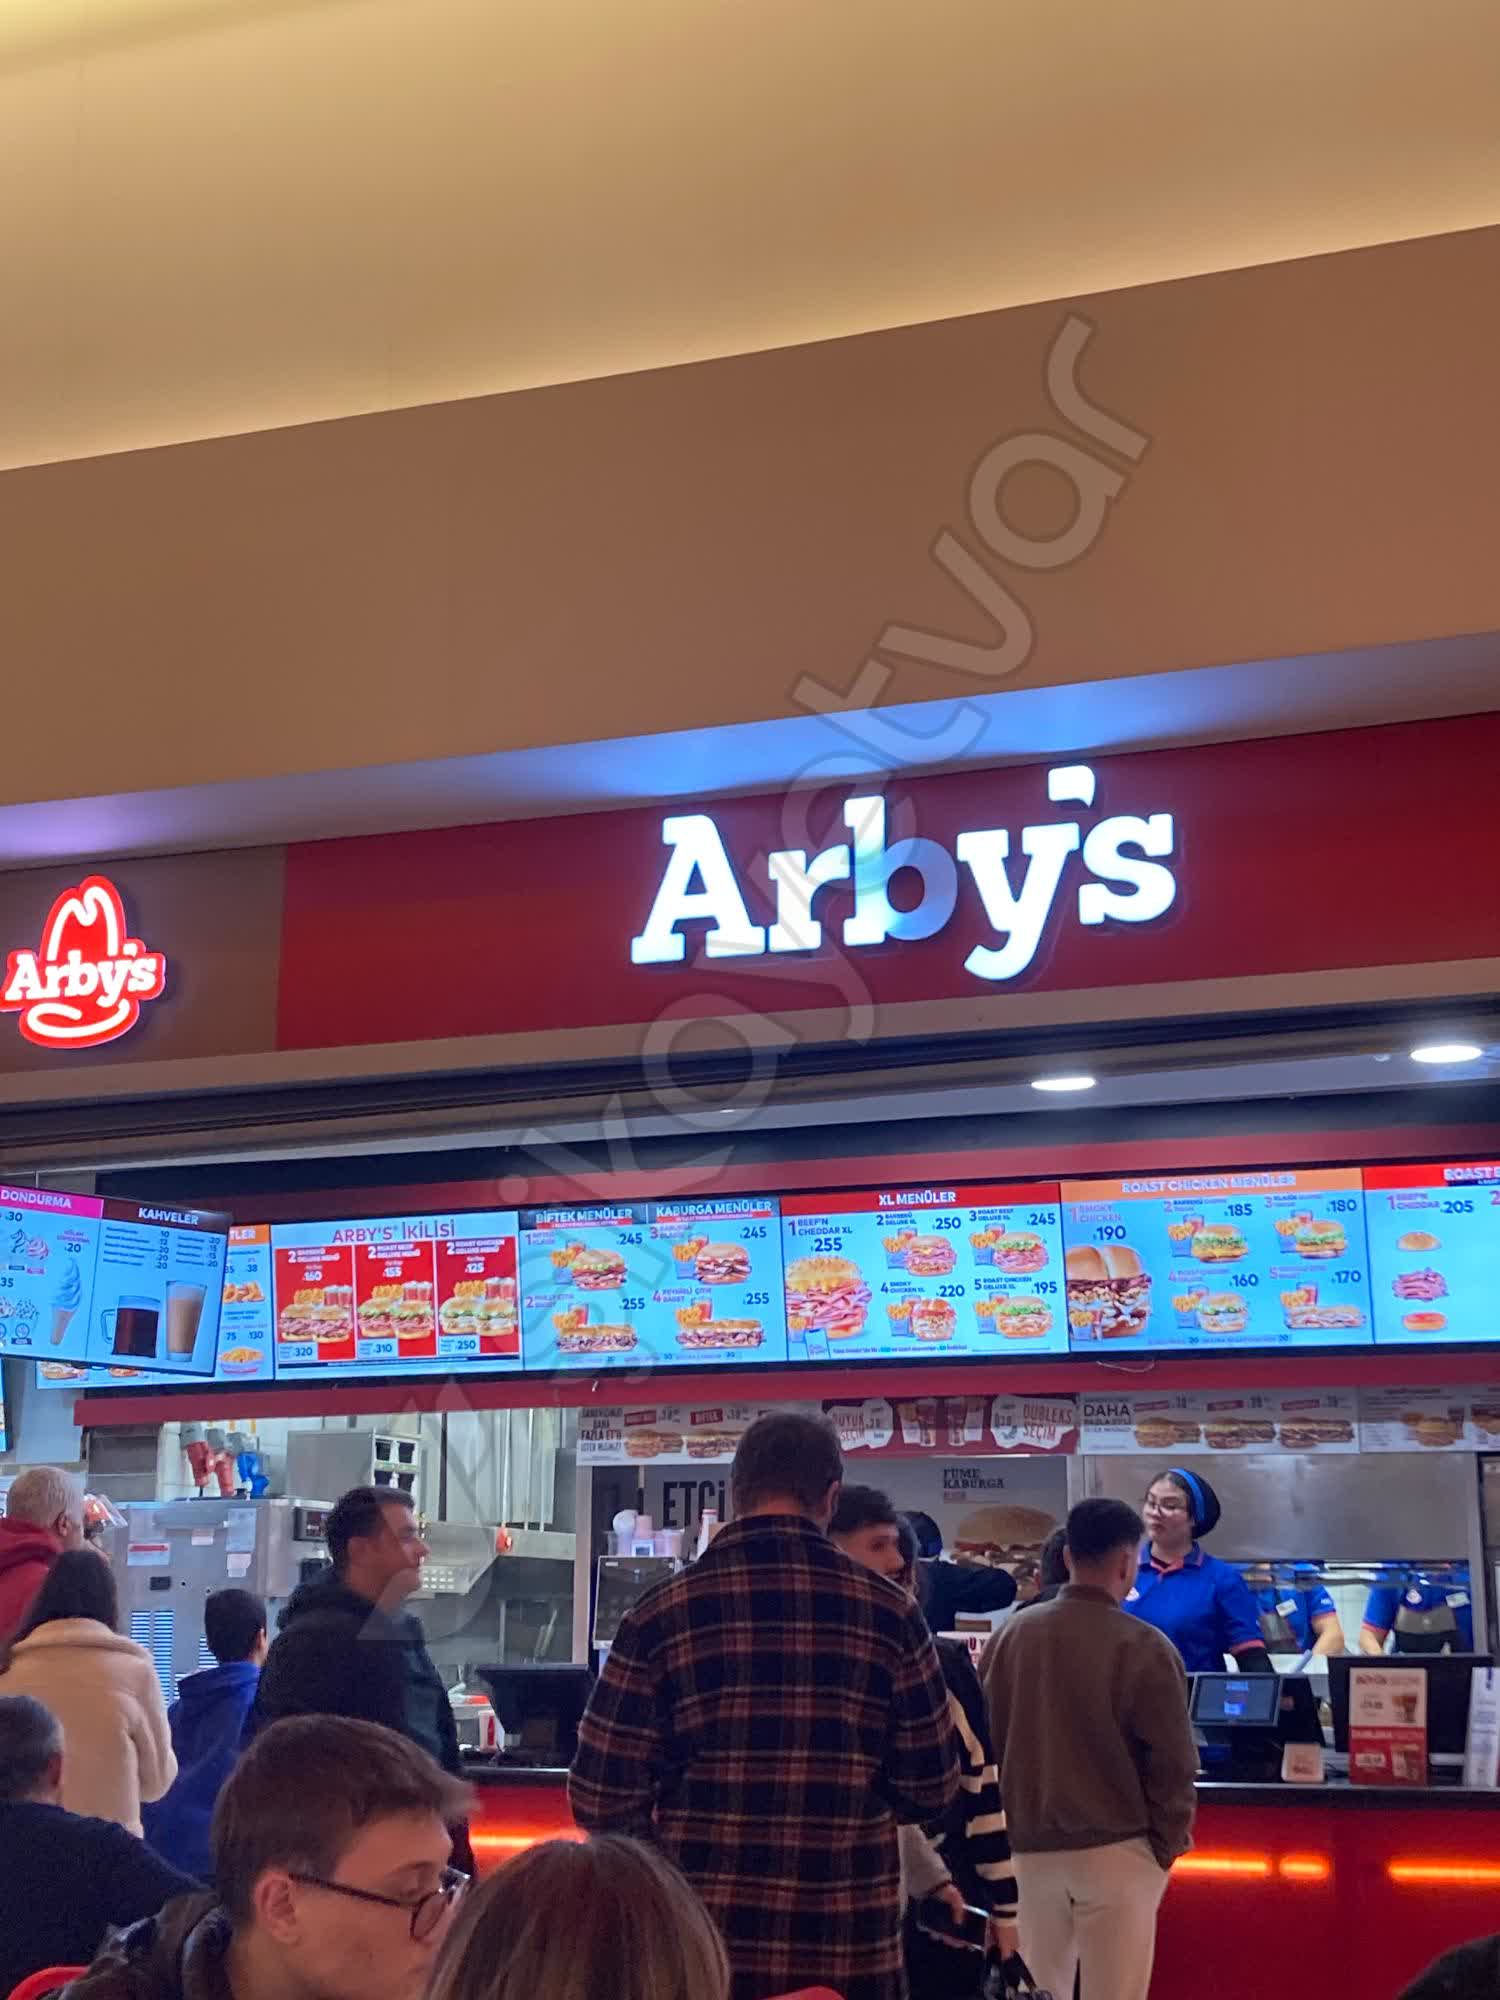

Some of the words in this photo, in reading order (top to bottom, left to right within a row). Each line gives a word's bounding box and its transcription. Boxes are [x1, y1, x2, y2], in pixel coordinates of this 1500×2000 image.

[631, 765, 1177, 981] Arby's
[4, 943, 157, 1009] Arby's
[1444, 1166, 1493, 1181] ROAST
[1121, 1181, 1165, 1194] ROAST
[1167, 1177, 1229, 1192] CHICKEN
[1, 1189, 72, 1209] DONDURMA
[878, 1195, 895, 1206] XL
[896, 1190, 957, 1205] MENÜLER
[577, 1207, 633, 1221] MENÜLER
[656, 1204, 713, 1217] KABURGA
[715, 1200, 772, 1215] MENÜLER
[1227, 1203, 1253, 1217] 185
[1442, 1200, 1474, 1214] 205
[138, 1207, 199, 1225] KAHVELER
[876, 1214, 884, 1226] 2
[934, 1216, 962, 1230] 250
[969, 1210, 977, 1222] 3
[1029, 1212, 1056, 1226] 245
[332, 1226, 393, 1243] ARBY'S
[402, 1218, 456, 1240] İKİLİSİ
[742, 1226, 767, 1239] 245
[788, 1219, 796, 1236] 1
[798, 1227, 840, 1237] CHEDDAR
[841, 1226, 853, 1234] XL
[1096, 1225, 1127, 1241] 190
[618, 1232, 643, 1245] 245
[813, 1237, 843, 1252] 255
[367, 1246, 377, 1259] 2
[446, 1242, 456, 1255] 2
[288, 1250, 297, 1264] 2
[1232, 1273, 1259, 1287] 160
[1334, 1270, 1362, 1284] 170
[880, 1283, 888, 1293] 4
[938, 1284, 965, 1297] 220
[974, 1279, 982, 1290] 5
[1033, 1281, 1057, 1294] 195
[622, 1298, 646, 1310] 255
[746, 1292, 770, 1305] 255
[1083, 1404, 1130, 1417] DAHA
[943, 1479, 1004, 1490] KABURGA
